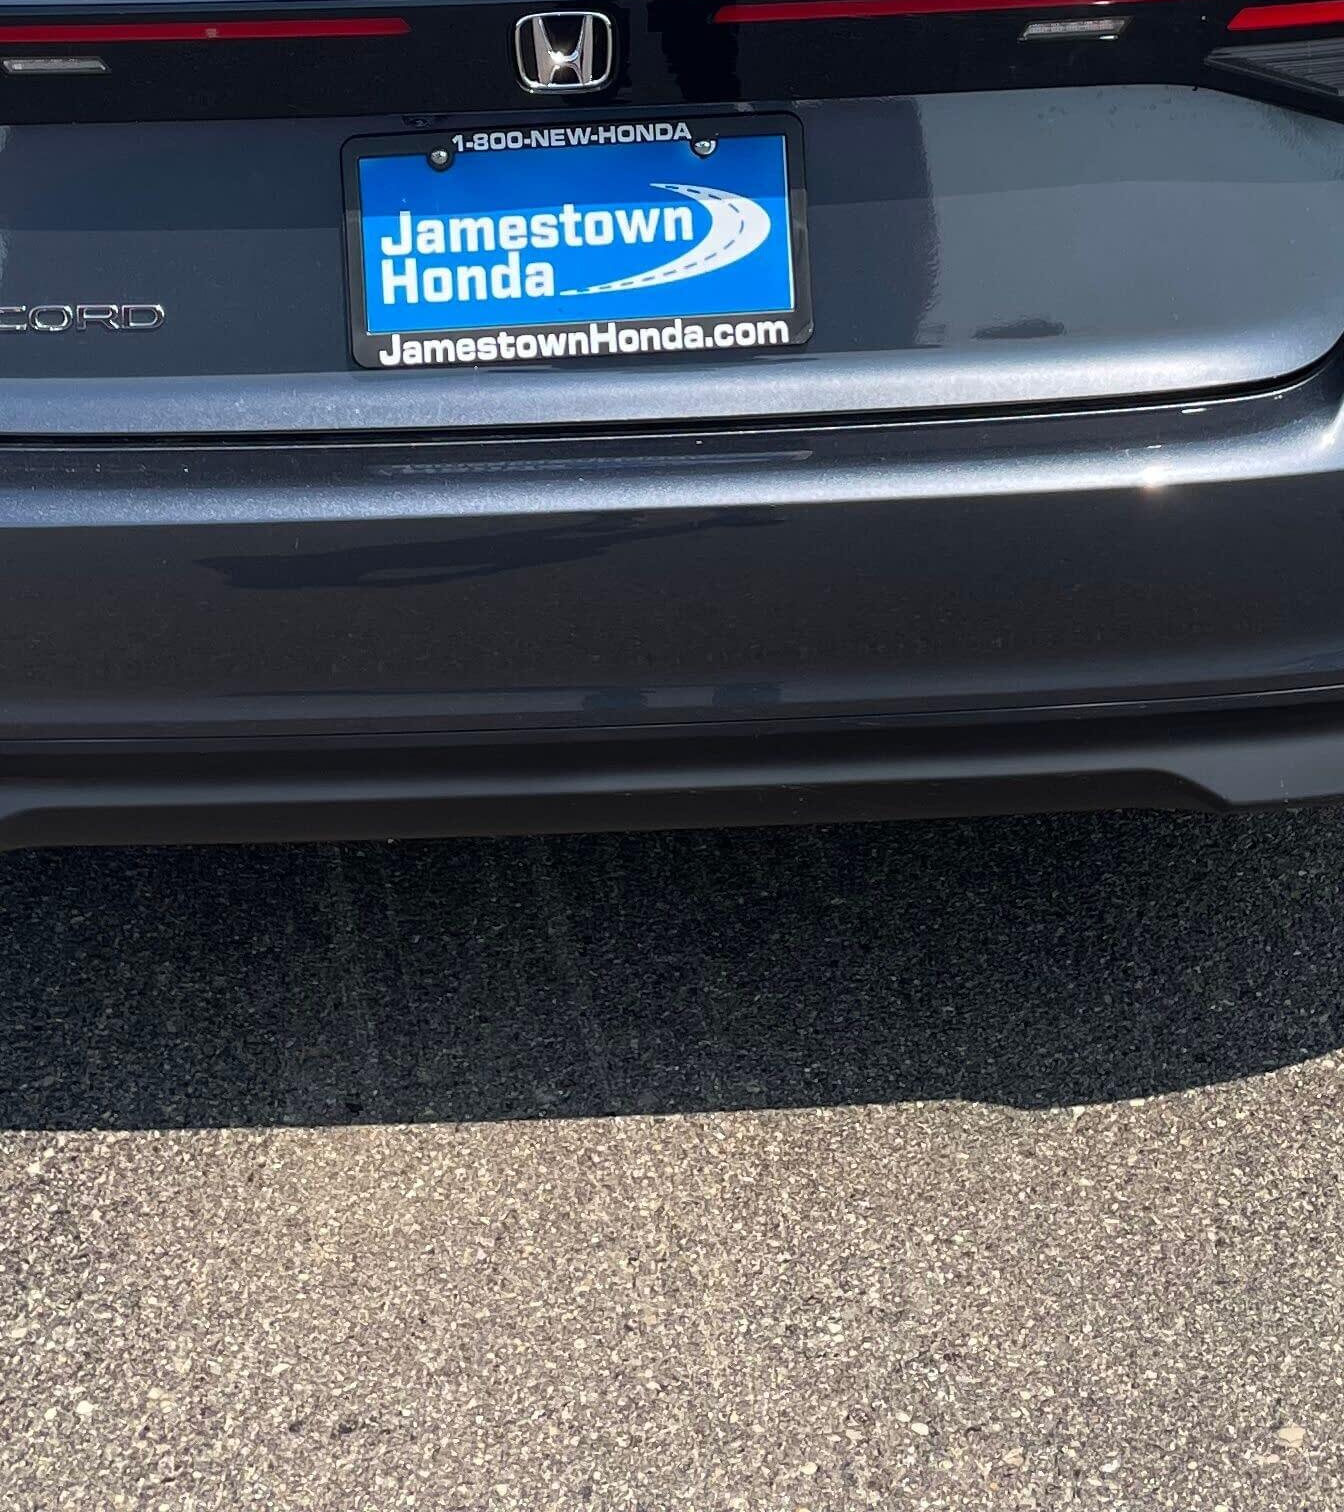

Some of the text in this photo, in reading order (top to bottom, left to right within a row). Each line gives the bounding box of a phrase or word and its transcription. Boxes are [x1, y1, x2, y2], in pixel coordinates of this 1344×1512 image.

[452, 122, 692, 152] 1-800-NEW-HONDA
[380, 203, 694, 256] Jamestown
[381, 250, 555, 305] Honda
[379, 318, 790, 367] JamestownHonda.com
